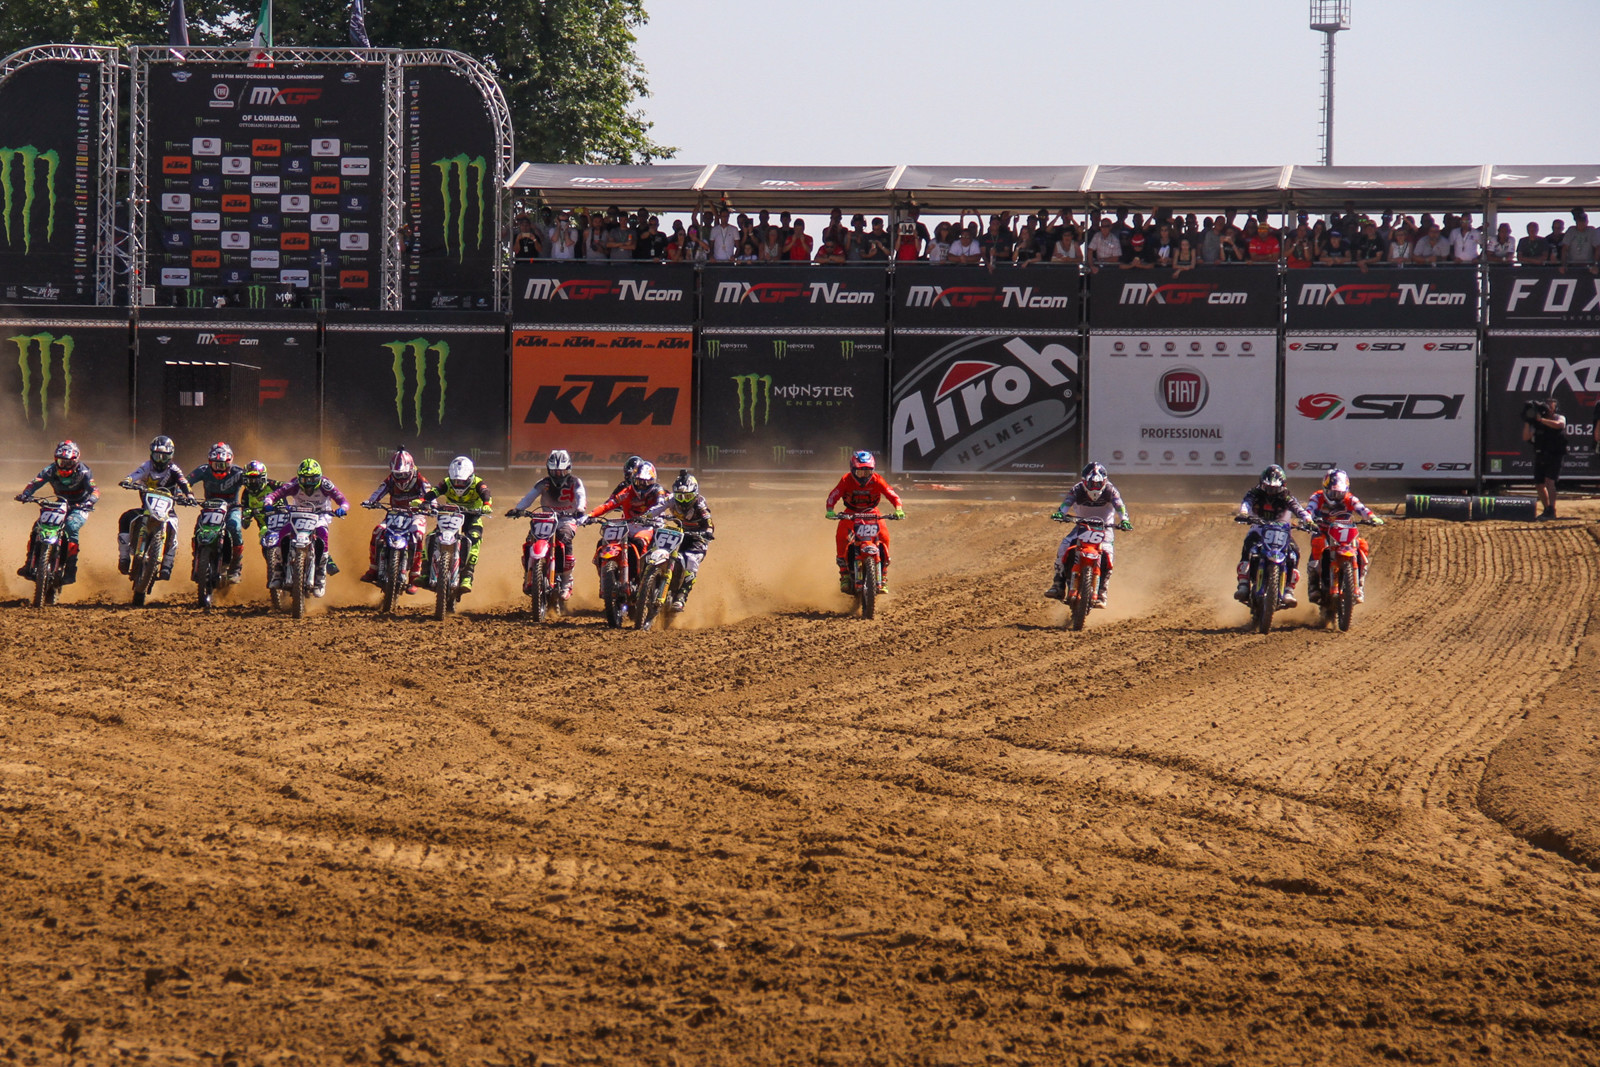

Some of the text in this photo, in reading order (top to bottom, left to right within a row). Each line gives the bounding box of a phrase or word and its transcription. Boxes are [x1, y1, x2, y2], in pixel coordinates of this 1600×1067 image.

[515, 335, 690, 349] KTM KTM KTM KTM
[1167, 380, 1198, 403] FIAT
[524, 374, 680, 426] KTM
[957, 414, 1036, 465] HELMET
[1141, 427, 1223, 439] PROFESSIONAL
[571, 452, 594, 462] TM
[201, 512, 223, 525] 70
[294, 518, 317, 531] 66
[533, 522, 554, 535] 10
[603, 527, 625, 540] 61
[857, 524, 878, 536] 426
[1338, 528, 1349, 541] 1
[656, 533, 679, 549] 64
[1078, 530, 1105, 544] 46
[1263, 529, 1289, 545] 919
